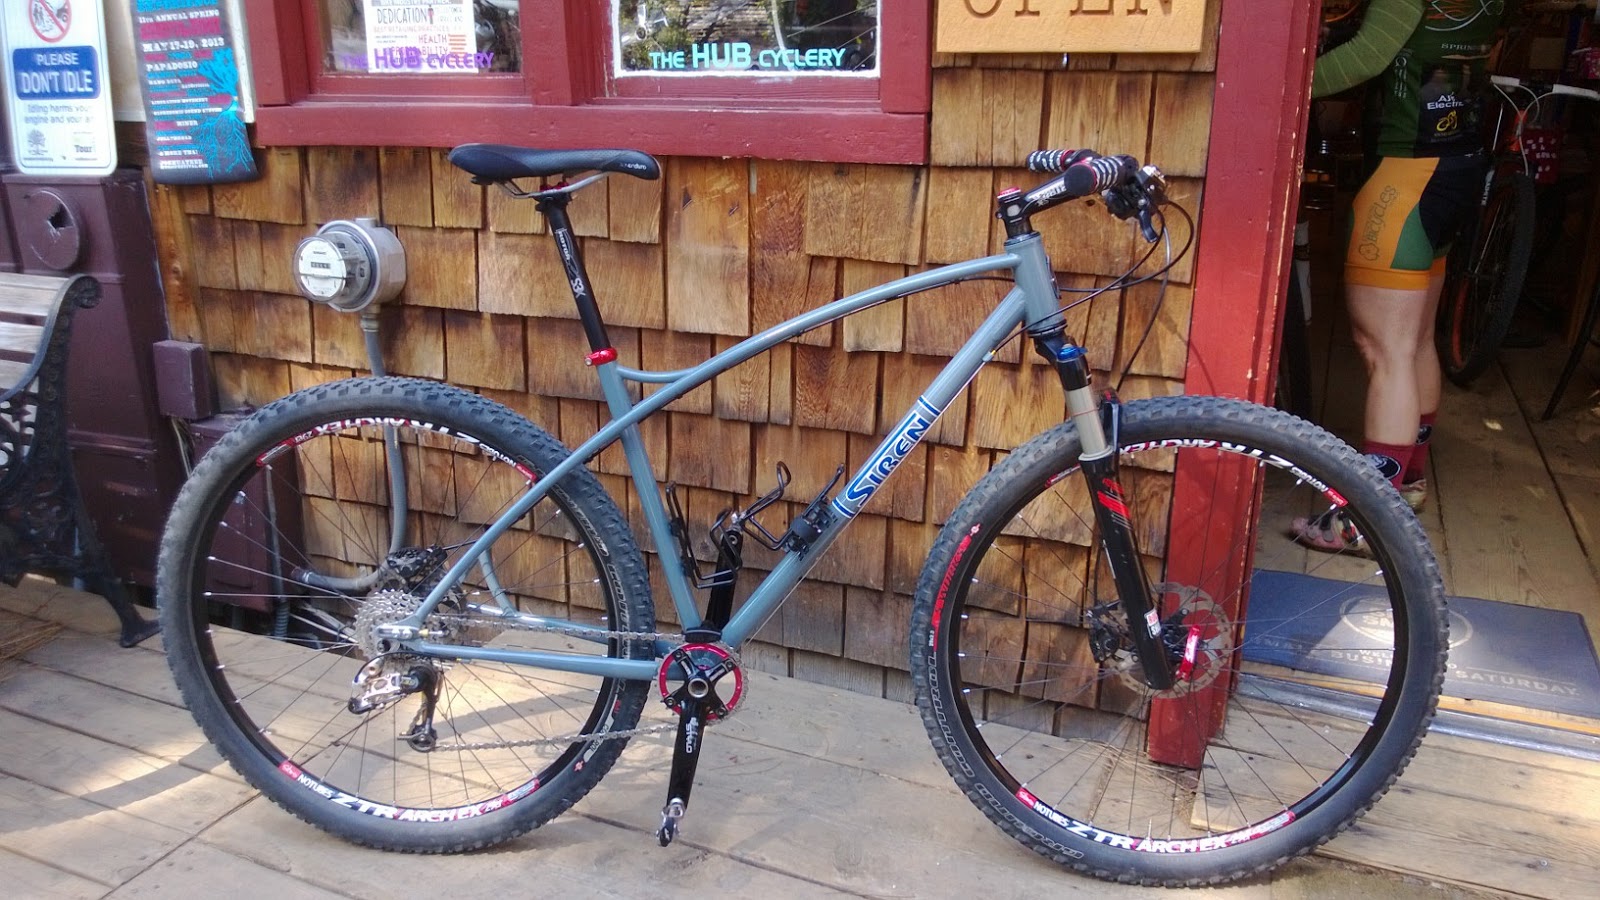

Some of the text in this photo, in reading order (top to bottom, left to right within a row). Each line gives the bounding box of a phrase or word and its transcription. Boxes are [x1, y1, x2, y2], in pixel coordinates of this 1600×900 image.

[156, 13, 188, 21] ANNUAL
[189, 9, 220, 18] SPRING
[377, 8, 427, 24] DEDICATION
[142, 42, 168, 52] MAY
[418, 34, 448, 43] HEALTH
[36, 53, 79, 66] PLEASE
[374, 48, 422, 69] HUB
[427, 53, 494, 69] CYCLERY
[650, 42, 846, 69] THE HUB CYCLERY
[22, 71, 94, 94] DON'T IDLE
[50, 115, 64, 123] and
[846, 410, 931, 508] SIREN
[298, 775, 332, 799] NOTUBES
[333, 792, 397, 819] ZTR
[1034, 801, 1069, 827] NOTUBES
[1066, 820, 1135, 850] ZTR
[1137, 838, 1199, 853] ARCH
